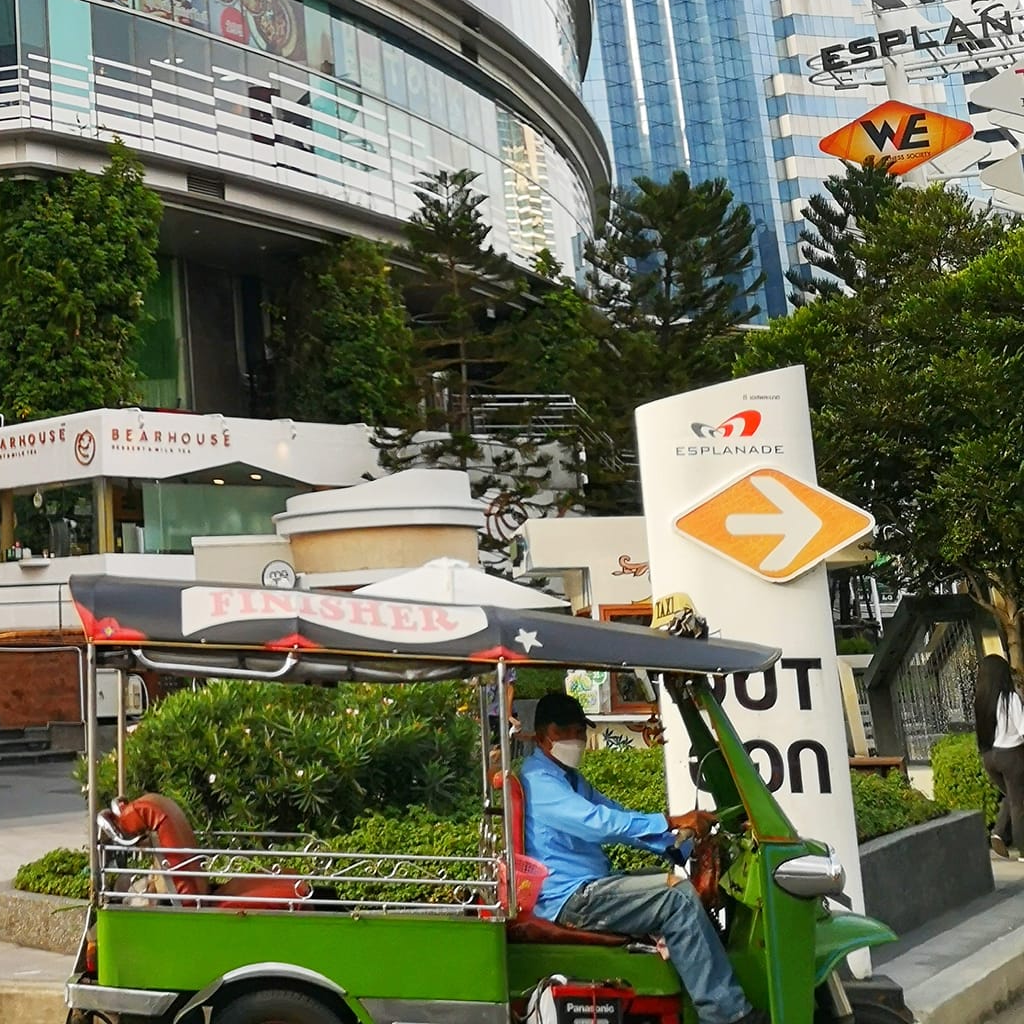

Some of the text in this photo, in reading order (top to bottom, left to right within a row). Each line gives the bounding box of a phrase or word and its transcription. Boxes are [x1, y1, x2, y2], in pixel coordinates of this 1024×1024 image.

[860, 112, 930, 153] WE
[111, 428, 231, 447] BEARHOUSE
[676, 444, 784, 456] ESPLANADE
[210, 590, 459, 631] FINISHER
[656, 596, 675, 619] TAXI
[566, 1002, 615, 1014] Panasonic
